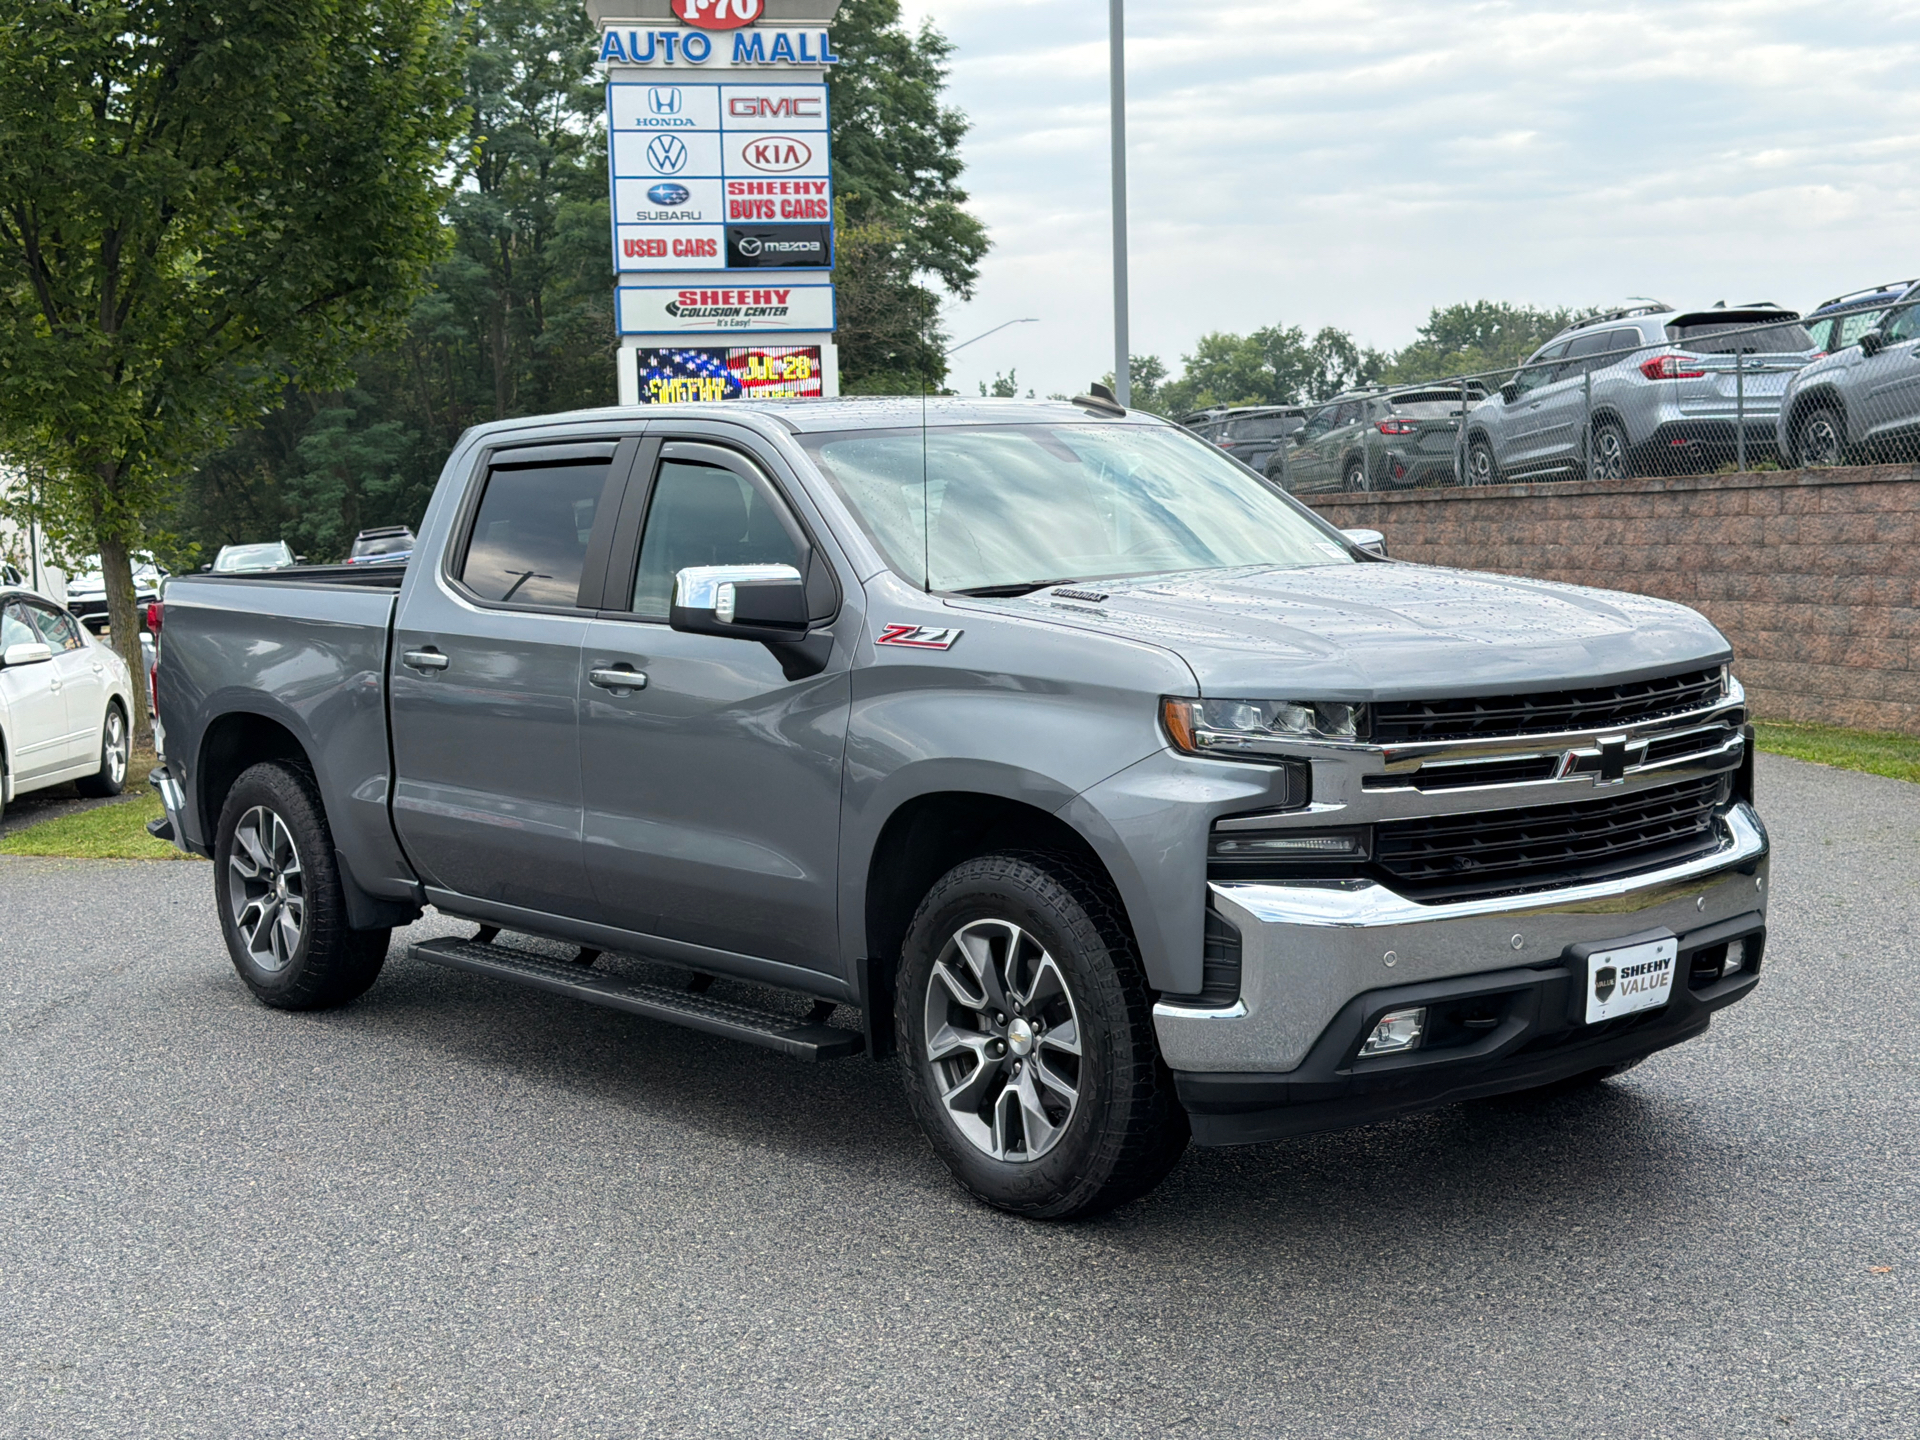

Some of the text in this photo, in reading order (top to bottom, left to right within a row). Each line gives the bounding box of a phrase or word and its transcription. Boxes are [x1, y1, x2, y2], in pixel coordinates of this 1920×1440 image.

[598, 31, 839, 64] AUTO MALL
[728, 97, 822, 118] GMC
[635, 118, 696, 127] HONDA
[755, 144, 800, 164] KIA
[728, 182, 827, 195] SHEEHY
[636, 211, 702, 221] SUBARU
[729, 198, 828, 220] BUYS CARS
[623, 238, 718, 258] USED CARS
[677, 289, 791, 306] SHEEHY
[679, 306, 789, 318] COLLISION CENTER
[716, 318, 751, 328] It's Easy!
[743, 356, 779, 380] JUL
[874, 622, 965, 651] Z71
[1621, 958, 1671, 979] SHEEHY
[1596, 979, 1614, 988] VALUE
[1621, 972, 1669, 996] VALUE
